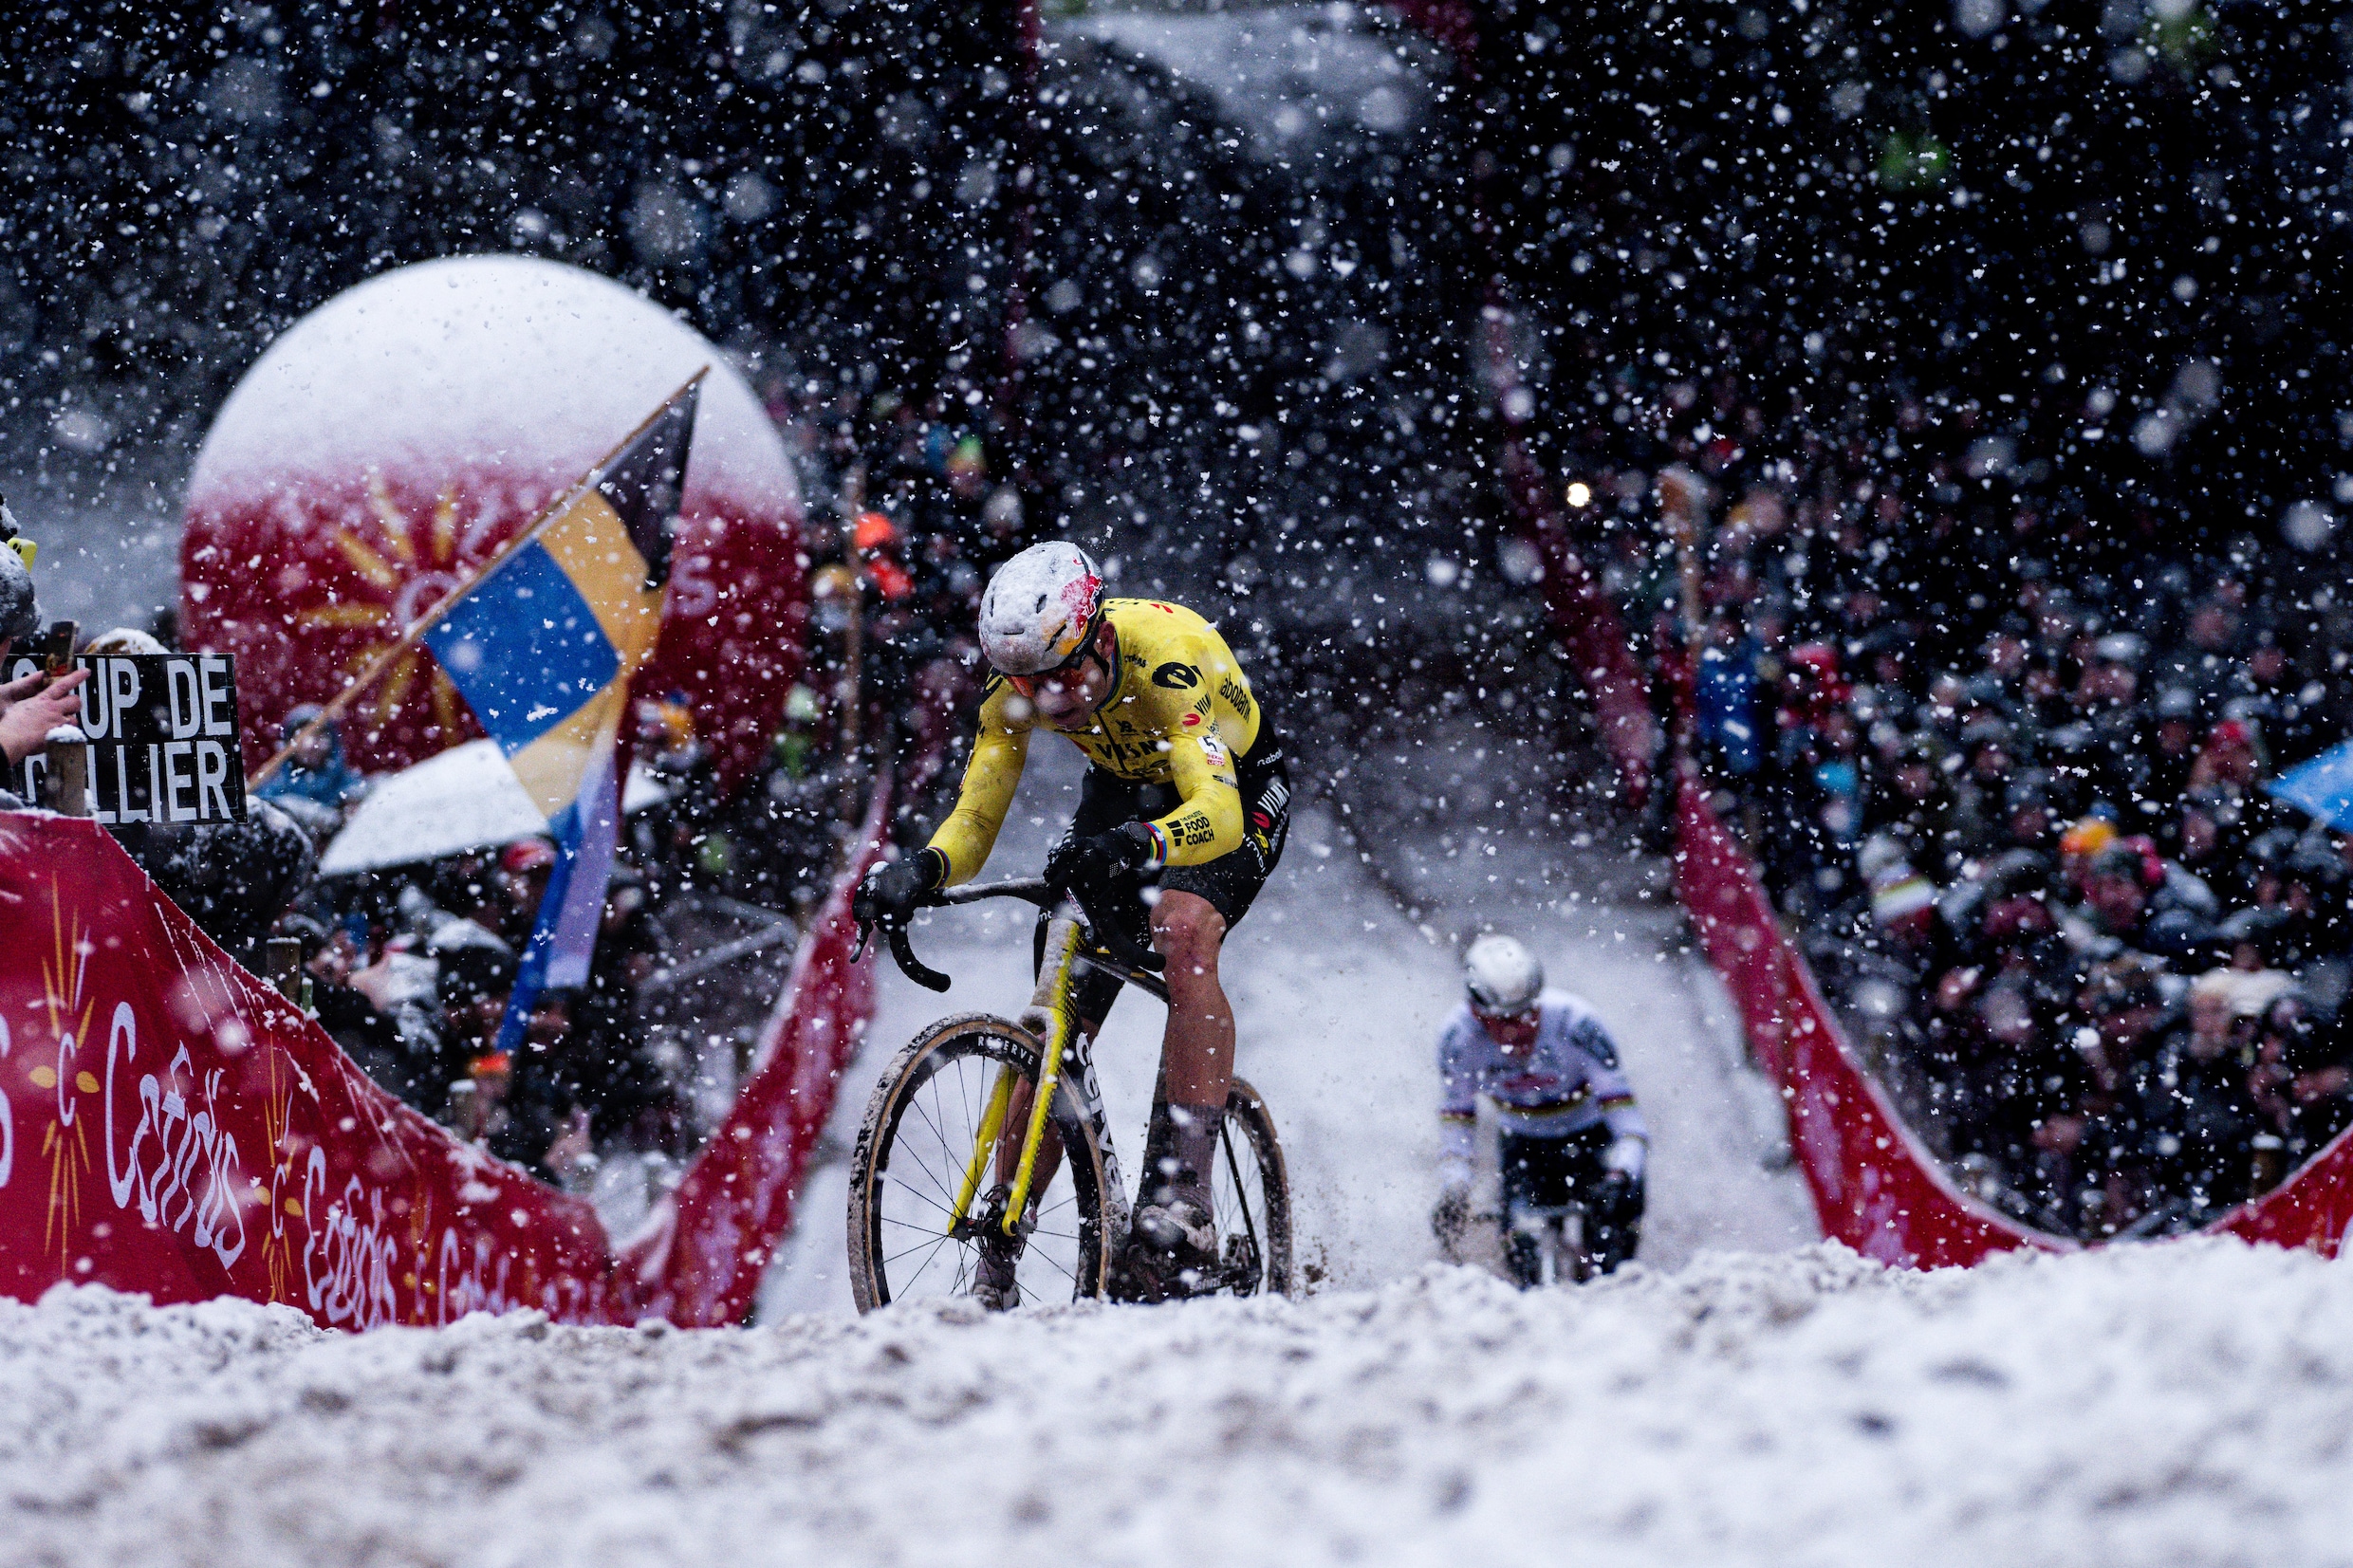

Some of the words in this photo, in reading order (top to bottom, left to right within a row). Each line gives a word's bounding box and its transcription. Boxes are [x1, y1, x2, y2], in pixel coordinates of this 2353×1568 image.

[166, 658, 232, 740] DE
[1184, 816, 1211, 833] FOOD
[1186, 828, 1214, 846] COACH
[977, 1035, 1034, 1065] RERVE
